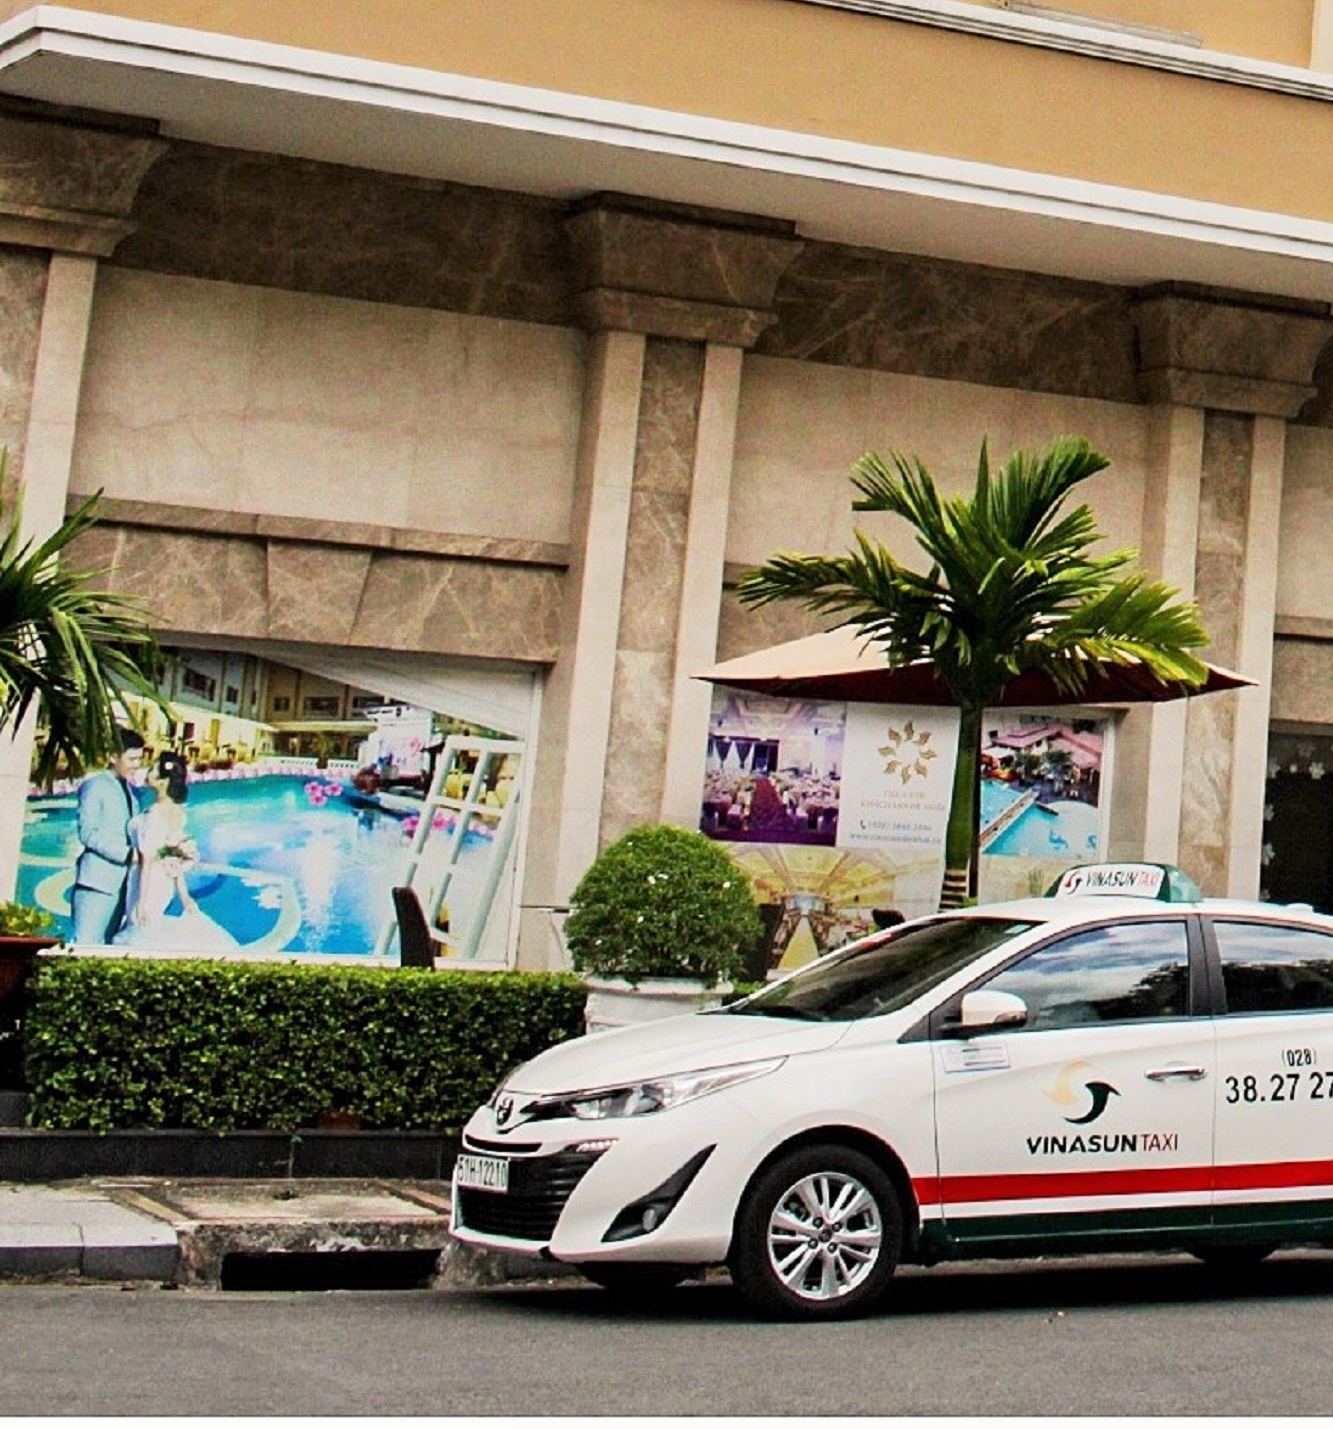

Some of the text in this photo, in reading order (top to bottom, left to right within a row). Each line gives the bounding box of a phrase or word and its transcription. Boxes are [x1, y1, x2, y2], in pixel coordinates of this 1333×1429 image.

[1086, 871, 1138, 887] VINASUN
[1281, 1046, 1317, 1067] (028)
[1225, 1074, 1299, 1104] 38.27
[1026, 1133, 1179, 1155] VINASUN TAXI
